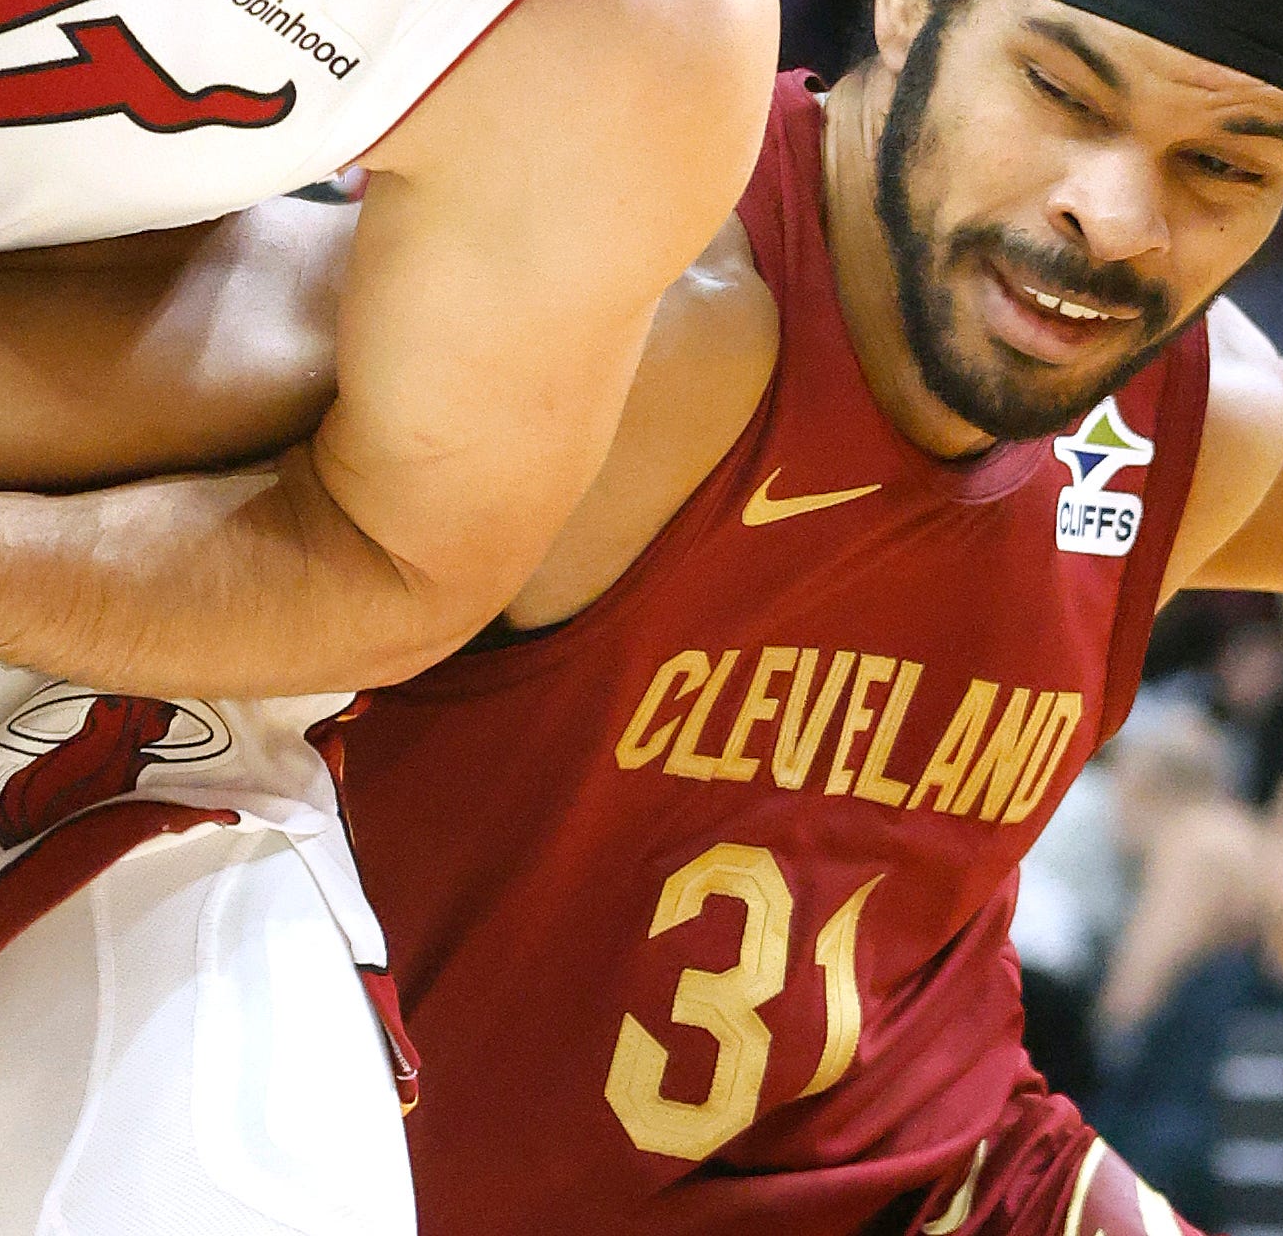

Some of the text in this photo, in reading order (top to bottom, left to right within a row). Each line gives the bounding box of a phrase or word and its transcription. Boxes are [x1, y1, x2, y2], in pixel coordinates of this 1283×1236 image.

[1059, 501, 1134, 541] CLIFFS
[614, 645, 1084, 824] CLEVELAND
[604, 842, 885, 1162] 31
